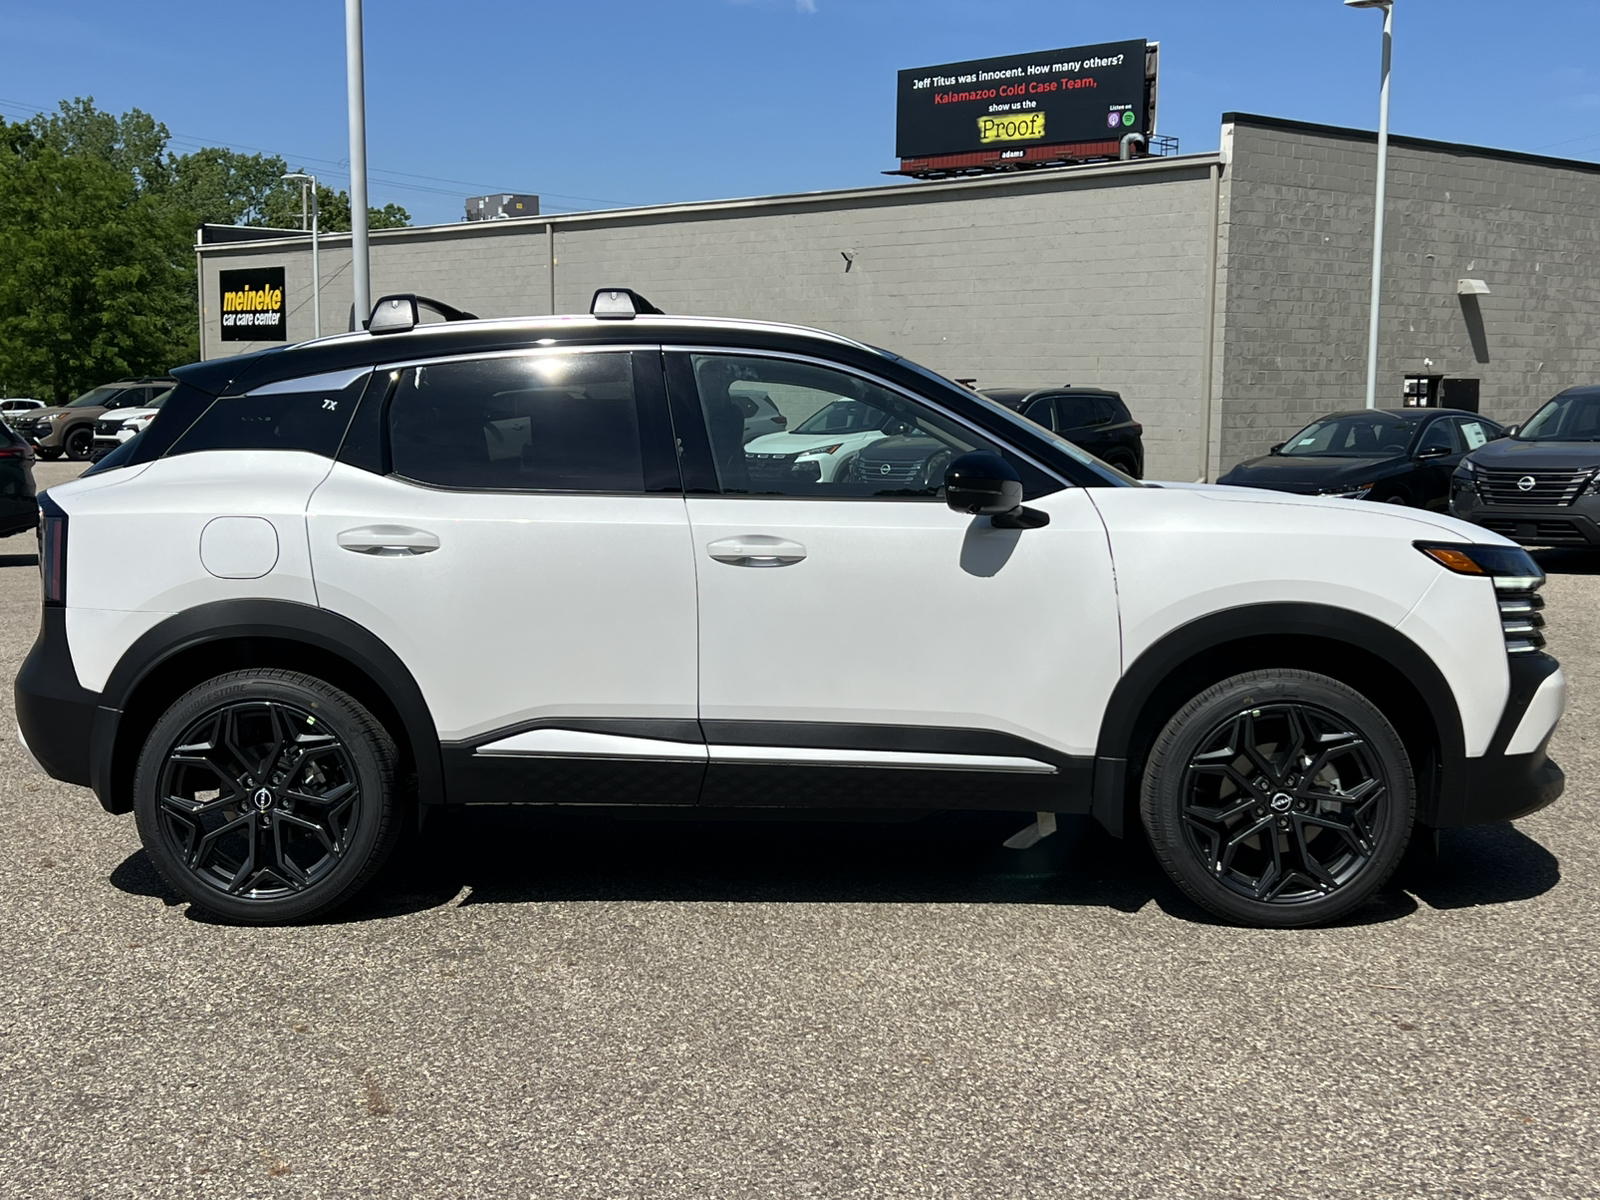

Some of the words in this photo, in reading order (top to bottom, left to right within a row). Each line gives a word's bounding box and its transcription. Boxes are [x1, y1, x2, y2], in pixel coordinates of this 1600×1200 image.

[913, 78, 931, 89] Jeff
[932, 76, 956, 87] Titus
[957, 73, 977, 83] was
[978, 67, 1025, 82] innocent.
[1027, 64, 1050, 76] How
[1052, 61, 1081, 72] many
[1083, 54, 1124, 69] others?
[934, 89, 997, 105] Kalamazoo
[999, 82, 1026, 97] Cold
[1028, 81, 1058, 94] Case
[1060, 77, 1097, 90] Team,
[988, 103, 1010, 112] show
[1011, 102, 1021, 110] us
[1022, 100, 1037, 109] the
[981, 114, 1042, 139] Proof.
[1001, 150, 1024, 159] adams
[223, 284, 282, 311] meineke
[222, 313, 236, 326] car
[236, 313, 254, 326] care
[254, 310, 281, 326] center
